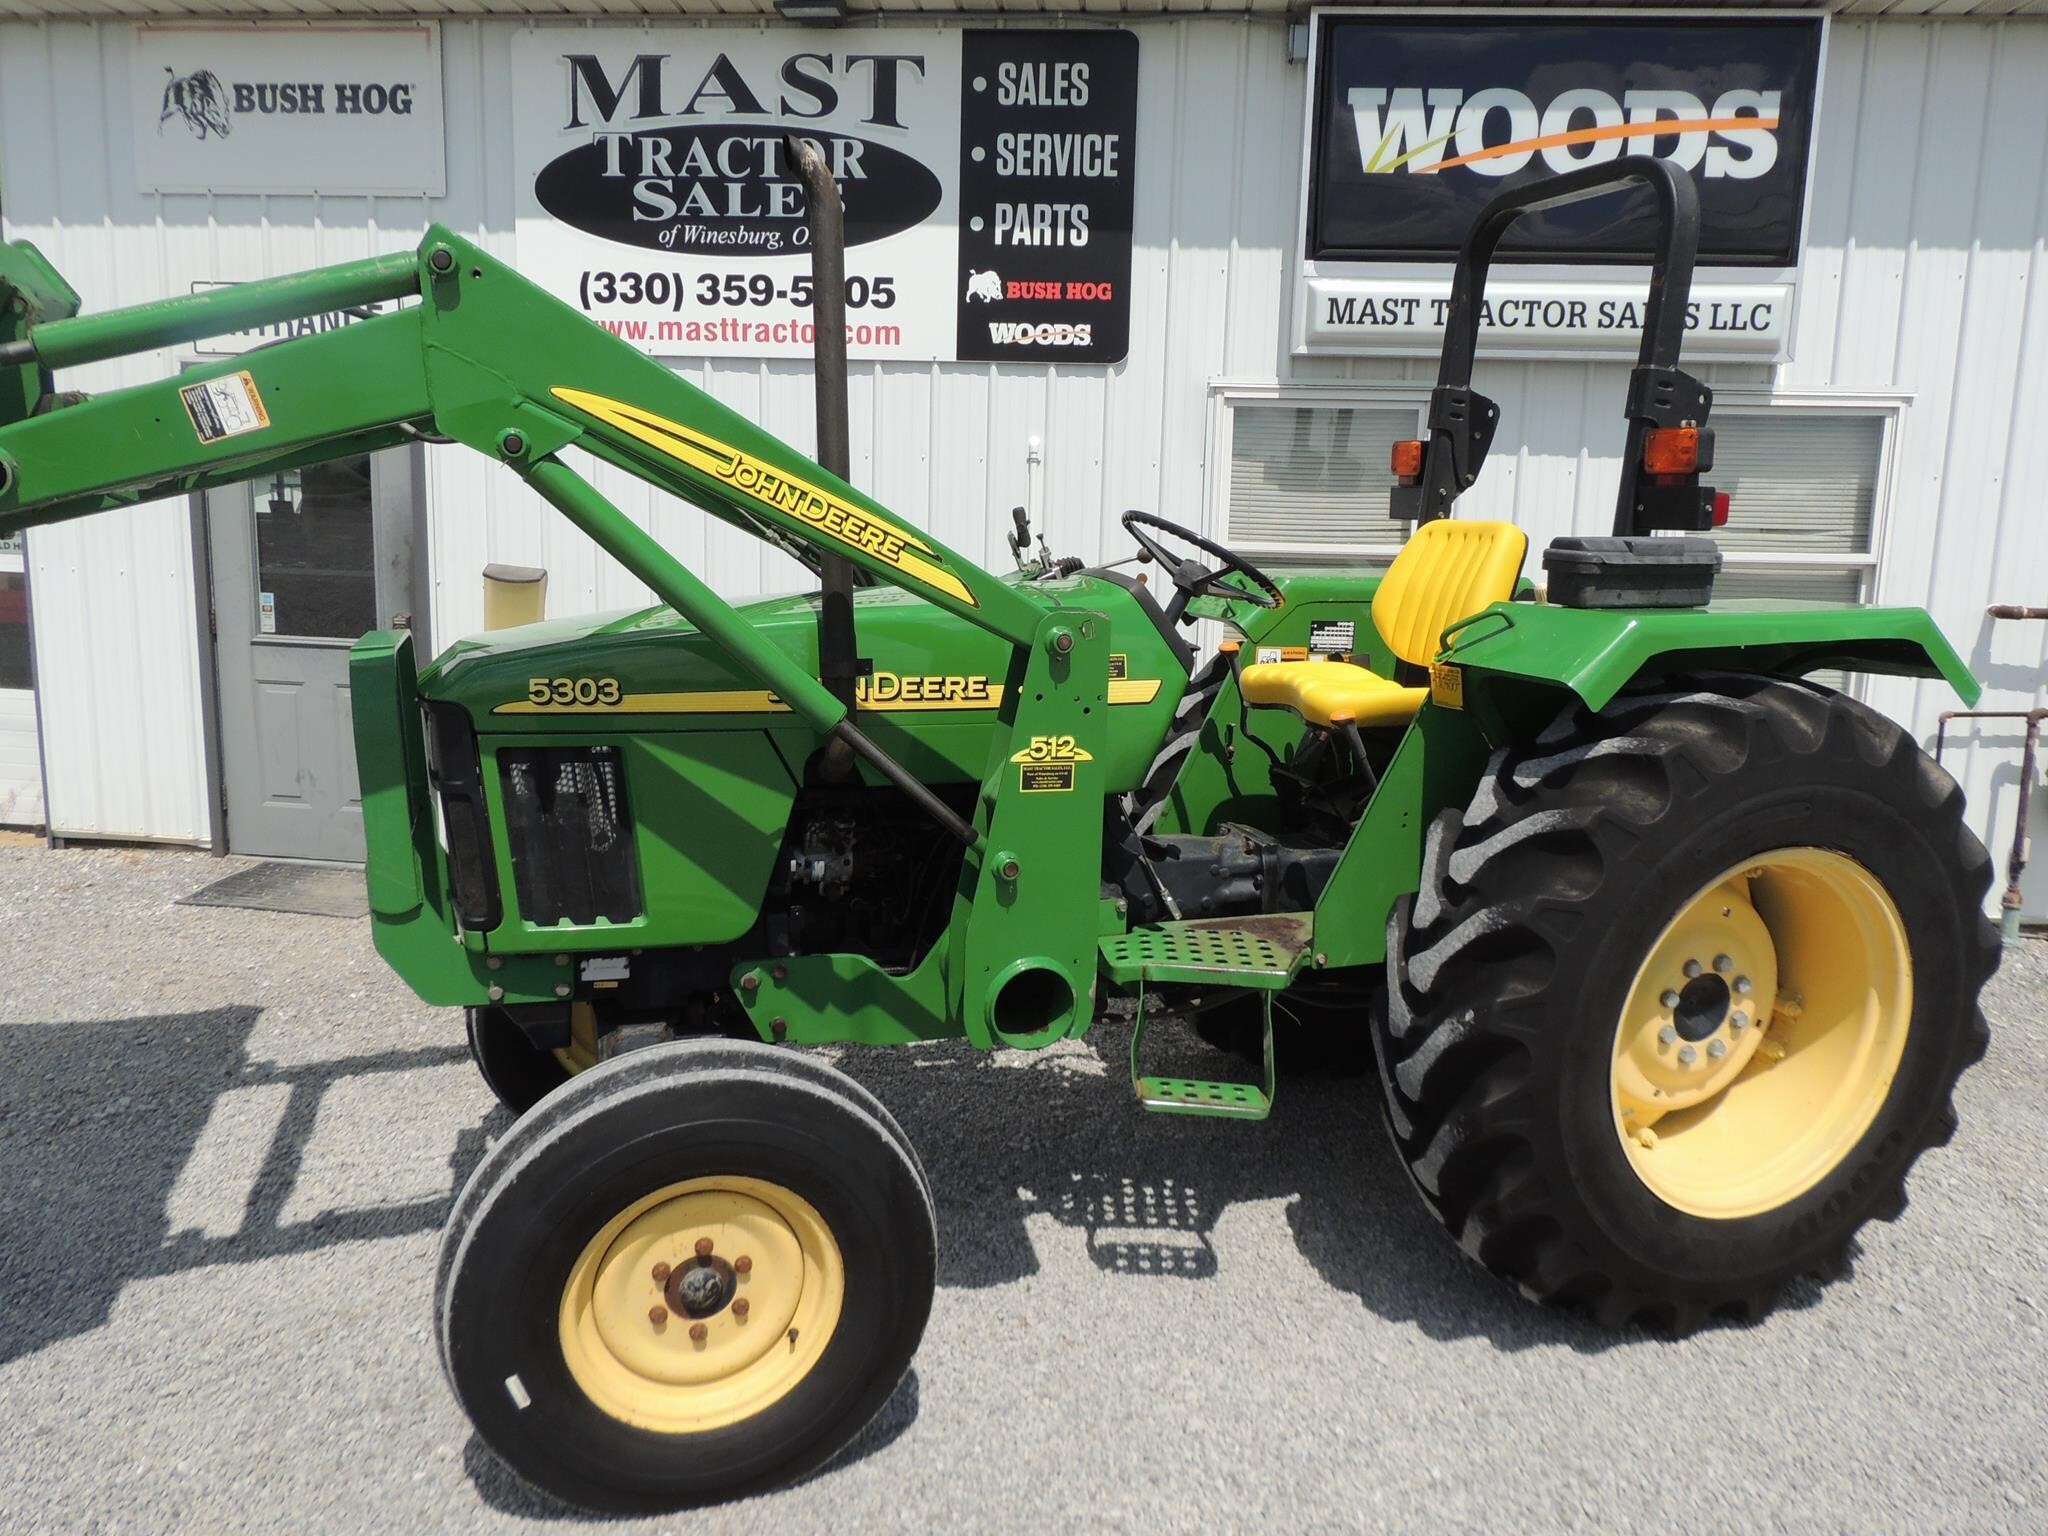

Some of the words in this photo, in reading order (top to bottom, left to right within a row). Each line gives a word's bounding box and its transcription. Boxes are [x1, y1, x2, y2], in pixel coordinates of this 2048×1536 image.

[232, 83, 325, 114] BUSH
[335, 83, 412, 115] HOG
[561, 53, 925, 129] MAST
[998, 62, 1089, 106] SALES
[1347, 87, 1782, 179] WOODS
[996, 132, 1119, 177] SERVICE
[633, 178, 846, 222] SALE
[658, 224, 681, 247] of
[683, 225, 784, 248] Winesburg,
[994, 203, 1089, 246] PARTS
[580, 271, 684, 312] (330)
[696, 273, 896, 309] 359-505
[1006, 281, 1062, 299] BUSH
[1066, 282, 1112, 300] HOG
[1327, 297, 1420, 325] MAST
[1430, 299, 1587, 328] TACTOR
[1597, 301, 1701, 330] SAS
[1709, 303, 1773, 331] LLC
[594, 318, 900, 345] ww.masttractoom
[989, 322, 1091, 346] WOODS
[528, 678, 622, 705] 5303
[1029, 735, 1076, 760] 512
